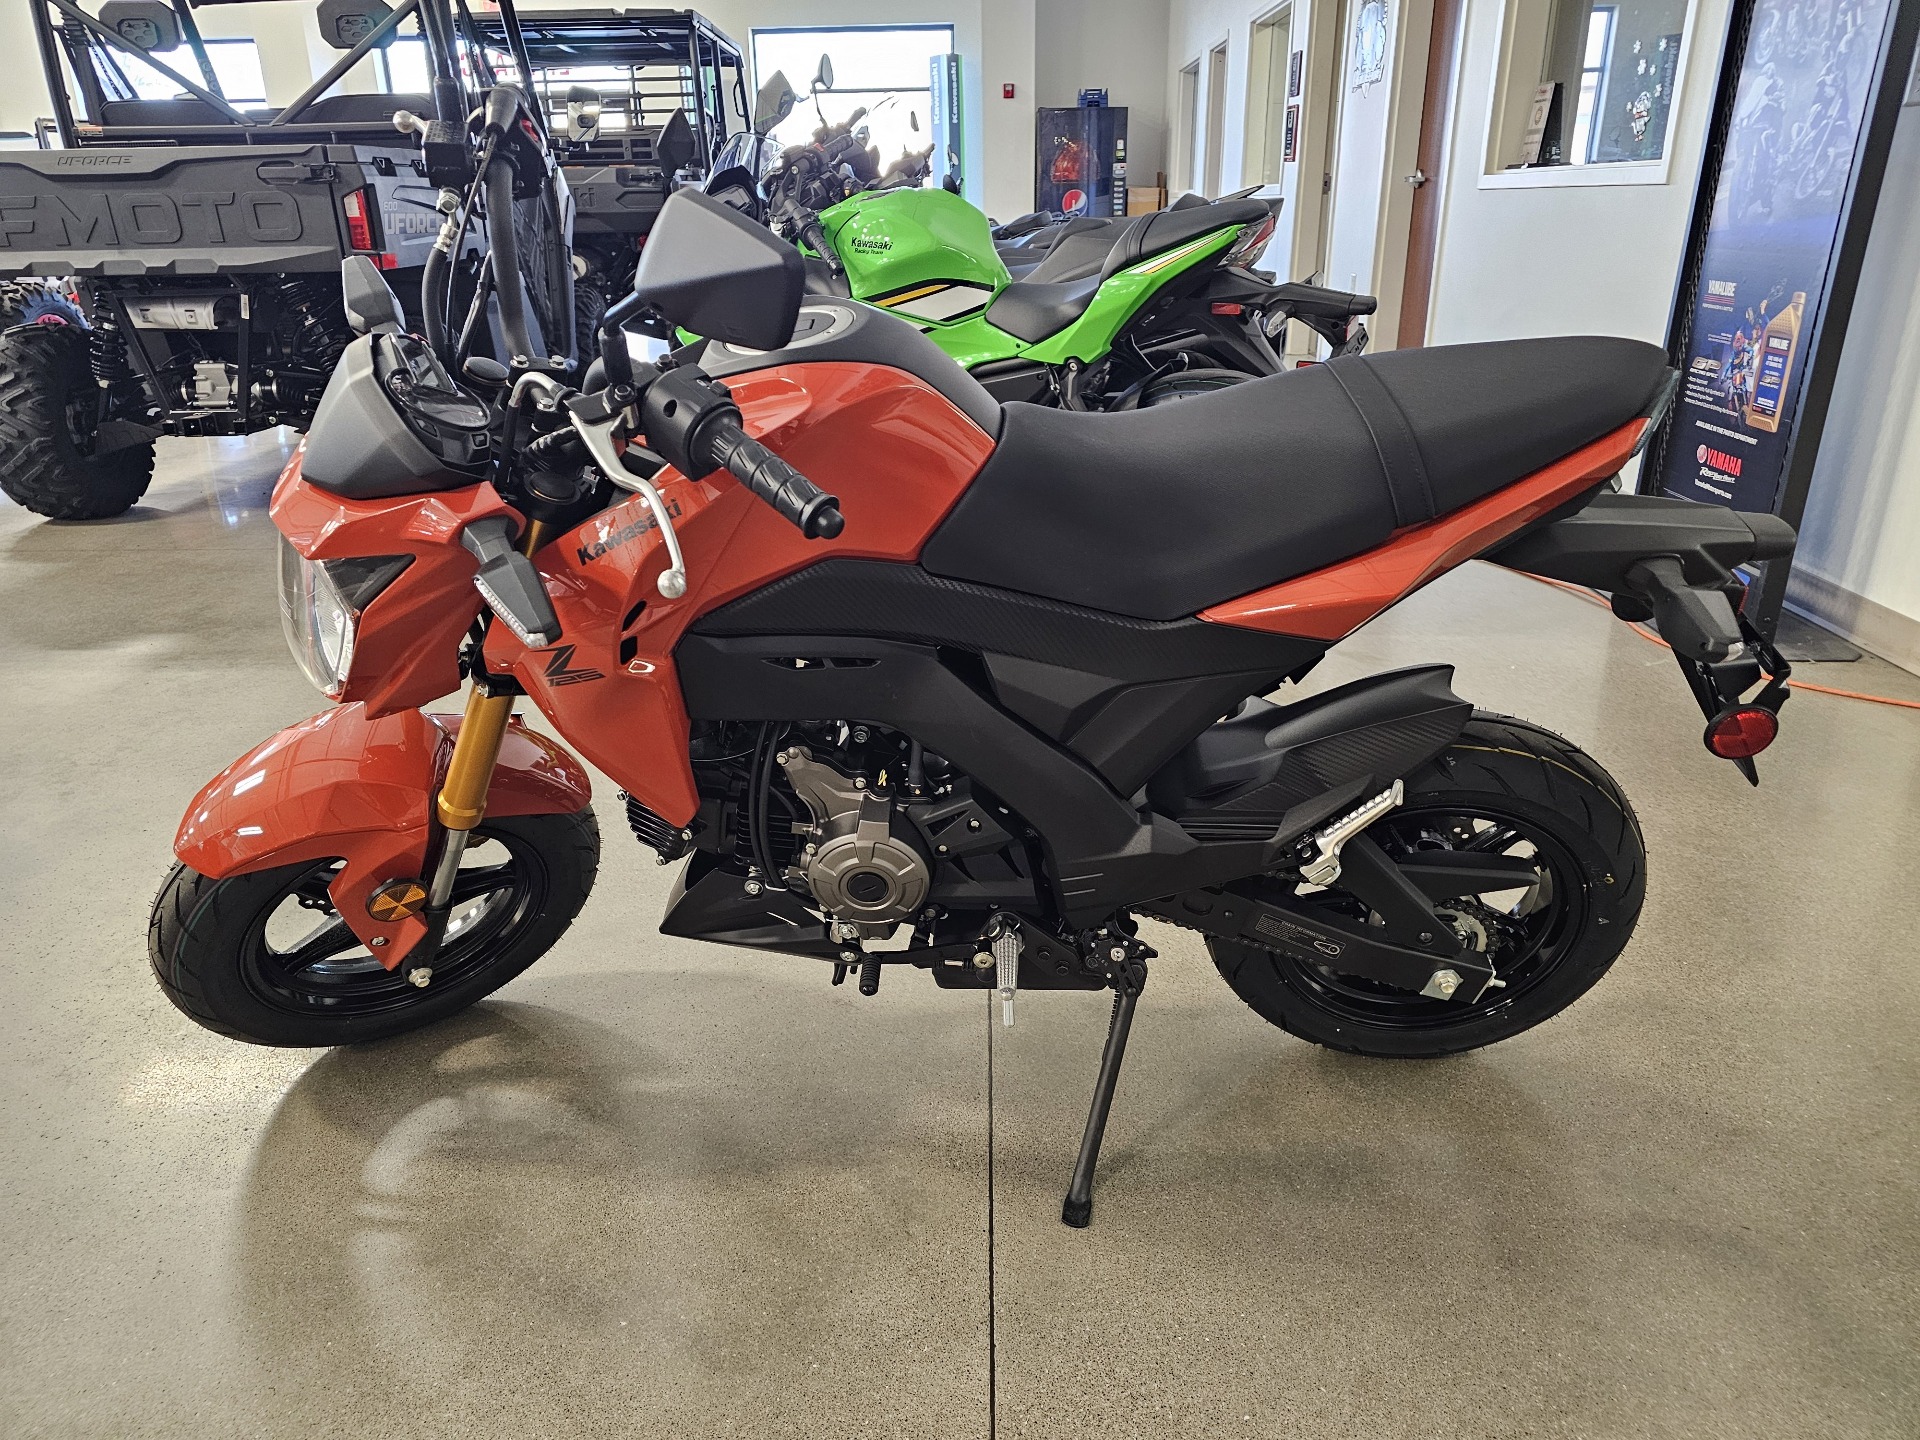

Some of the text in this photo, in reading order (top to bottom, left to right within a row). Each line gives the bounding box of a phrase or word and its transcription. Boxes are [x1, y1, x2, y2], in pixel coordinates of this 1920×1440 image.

[57, 155, 133, 166] UFORCE
[383, 201, 398, 211] 600
[851, 236, 894, 251] Kawasaki
[1707, 279, 1738, 297] YAMALUBE
[1706, 447, 1742, 477] YAMAHA
